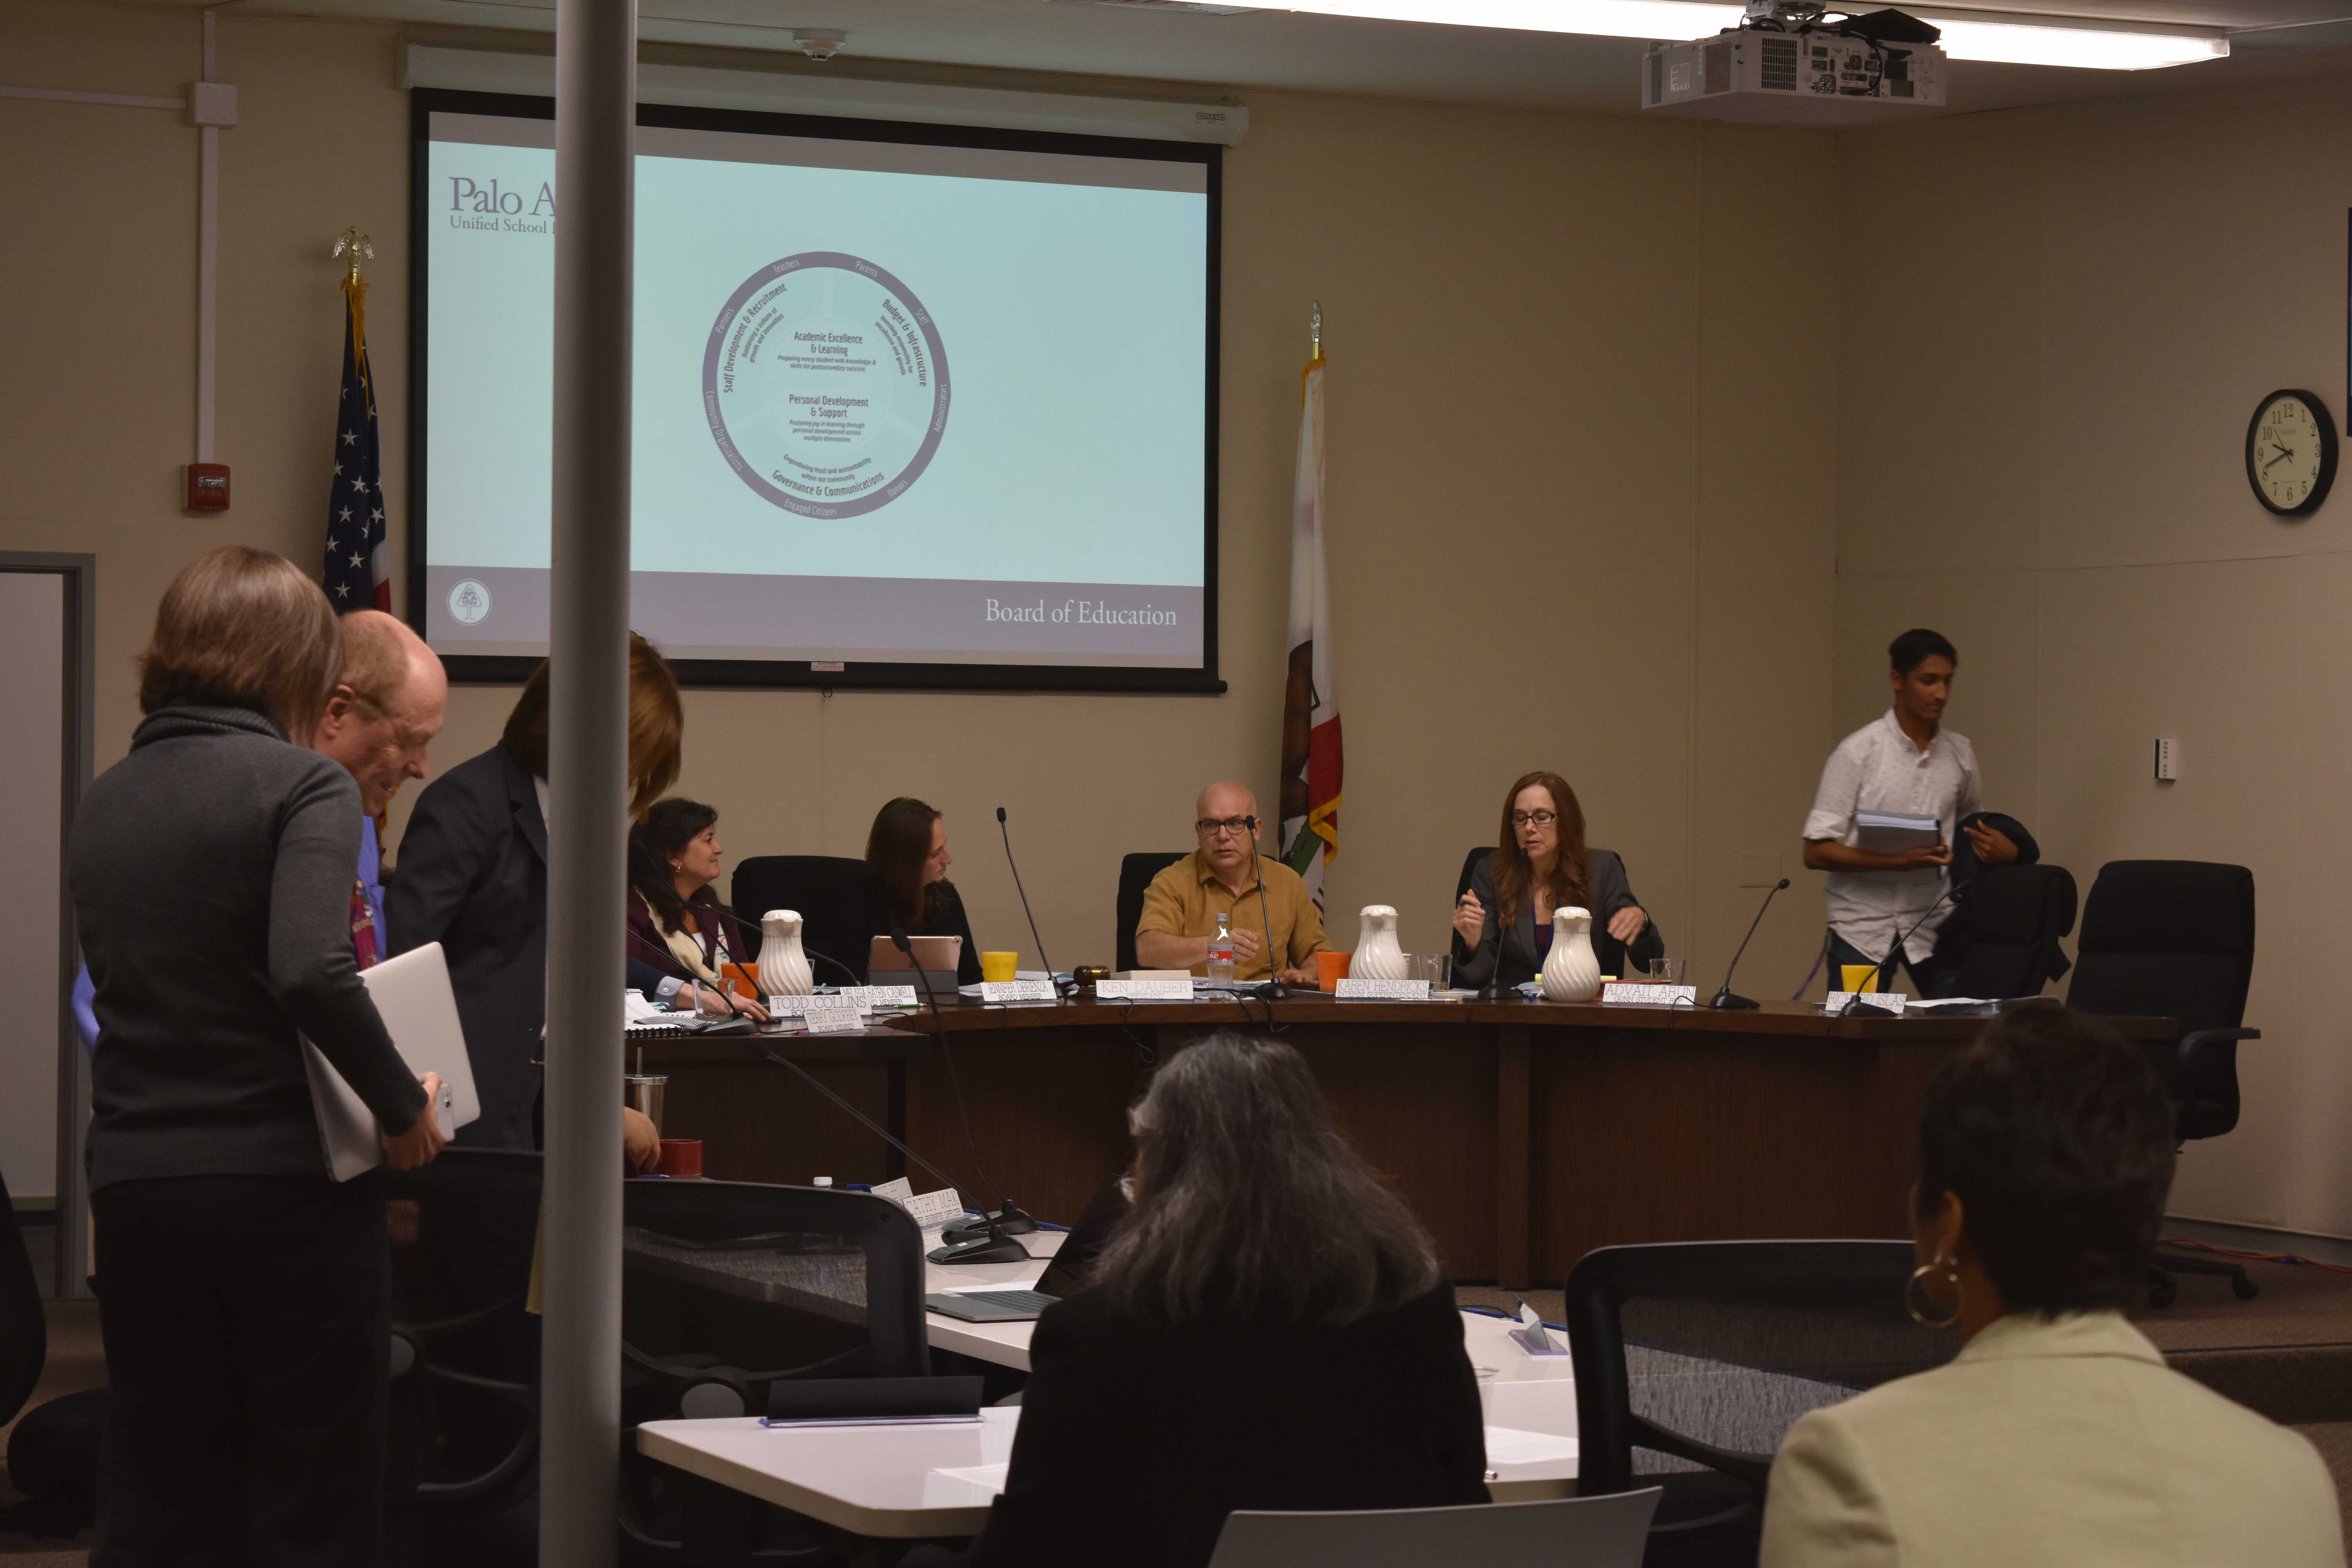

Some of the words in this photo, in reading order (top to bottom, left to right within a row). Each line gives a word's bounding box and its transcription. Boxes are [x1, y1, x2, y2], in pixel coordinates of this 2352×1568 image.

[449, 177, 523, 215] Palo
[450, 216, 499, 231] Unified
[504, 218, 547, 234] School
[773, 259, 800, 274] Teachers
[855, 261, 878, 277] Parents
[747, 283, 787, 318] Recruitment
[882, 299, 906, 325] Budget
[915, 309, 930, 326] Staff
[715, 307, 734, 334] Partners
[902, 323, 911, 331] &
[794, 331, 827, 342] Academic
[828, 333, 863, 344] Excellence
[724, 321, 748, 372] Development
[811, 344, 816, 353] &
[818, 344, 848, 357] Learning
[906, 330, 927, 387] Infrastructure
[724, 373, 734, 393] Staff
[789, 394, 820, 405] Personal
[822, 396, 869, 408] Development
[933, 384, 947, 433] Administrators
[810, 407, 816, 416] &
[818, 407, 848, 419] Support
[2272, 411, 2282, 424] 11
[2283, 403, 2294, 417] 12
[2301, 409, 2306, 423] 1
[706, 391, 720, 428] Community
[716, 429, 743, 472] Organizations
[2262, 426, 2272, 440] 10
[2310, 423, 2316, 437] 2
[2258, 447, 2264, 461] 9
[2315, 443, 2320, 458] 3
[2262, 466, 2269, 481] 8
[2311, 465, 2318, 479] 4
[772, 470, 814, 495] Governance
[816, 486, 822, 495] &
[824, 472, 885, 497] Communications
[887, 480, 908, 497] Donors
[2272, 482, 2278, 496] 7
[2301, 481, 2307, 495] 5
[2287, 486, 2293, 501] 6
[784, 498, 811, 514] Engaged
[812, 506, 837, 516] Citizens
[986, 599, 1044, 622] Board
[1052, 599, 1074, 623] of
[1078, 601, 1177, 626] Education
[1207, 951, 1219, 960] oke
[867, 987, 887, 999] BATEN
[887, 987, 914, 998] CASWELL
[987, 982, 1016, 995] JENNIFER
[1102, 982, 1128, 993] KEN
[1134, 982, 1189, 993] DAUBER
[1338, 980, 1370, 991] KAREN
[1373, 980, 1429, 992] HENDRICKS
[1605, 984, 1654, 997] ADVAIT
[1659, 986, 1696, 998] ARUN
[774, 997, 809, 1009] TODD
[814, 996, 867, 1009] COLLINS
[1828, 992, 1873, 1005] RICHRD
[1877, 994, 1906, 1007] ISLAS
[806, 1011, 828, 1024] TERRY
[828, 1009, 858, 1023] GODFREY
[905, 1195, 936, 1216] CATHY
[937, 1190, 960, 1209] MAK
